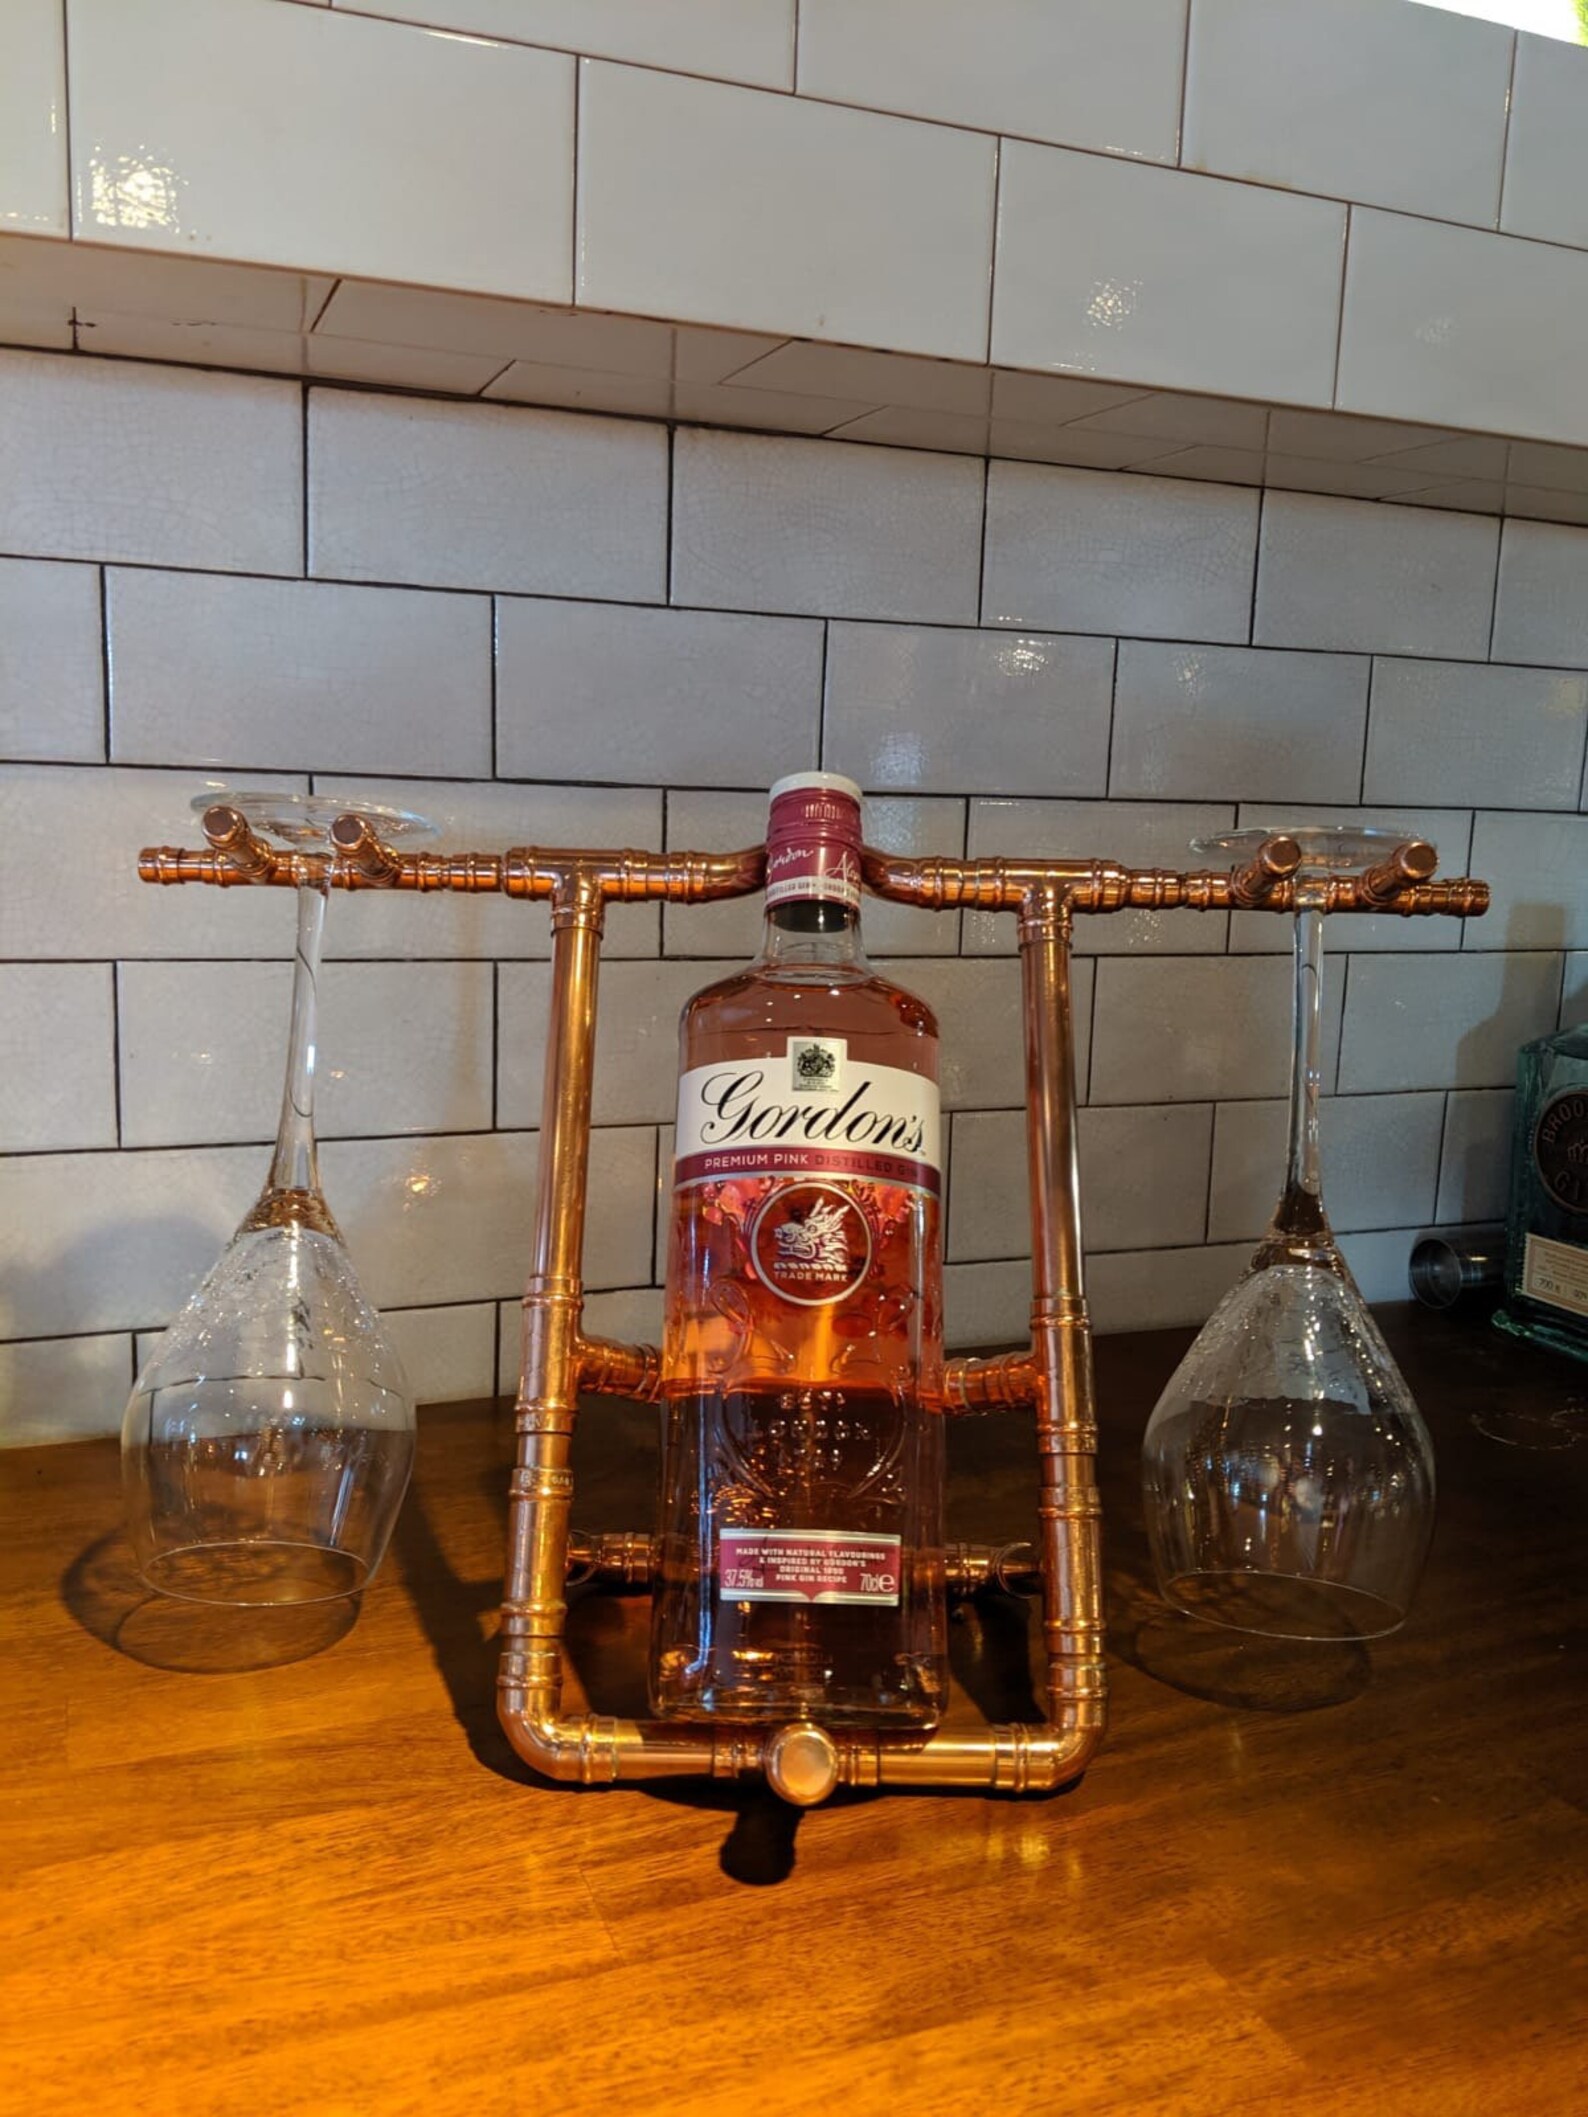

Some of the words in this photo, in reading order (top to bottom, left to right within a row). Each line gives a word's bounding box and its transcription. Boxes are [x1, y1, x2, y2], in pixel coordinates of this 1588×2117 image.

[700, 1070, 925, 1152] Gordon's
[704, 1153, 769, 1170] PREMIUM
[773, 1152, 810, 1166] PINK
[814, 1154, 893, 1173] DISTILLED
[773, 1270, 812, 1281] TRADE
[814, 1271, 848, 1283] MARK
[736, 1548, 759, 1556] MADE
[761, 1548, 784, 1556] WITH
[786, 1549, 827, 1558] NATURAL
[829, 1551, 885, 1560] FLAVOURINGS
[767, 1557, 808, 1566] INSPIRED
[810, 1558, 822, 1566] BY
[823, 1559, 866, 1567] GORDON'S
[779, 1566, 821, 1575] ORIGINAL
[775, 1574, 798, 1582] PINK
[799, 1574, 816, 1583] GIN
[817, 1575, 848, 1584] RECIPE
